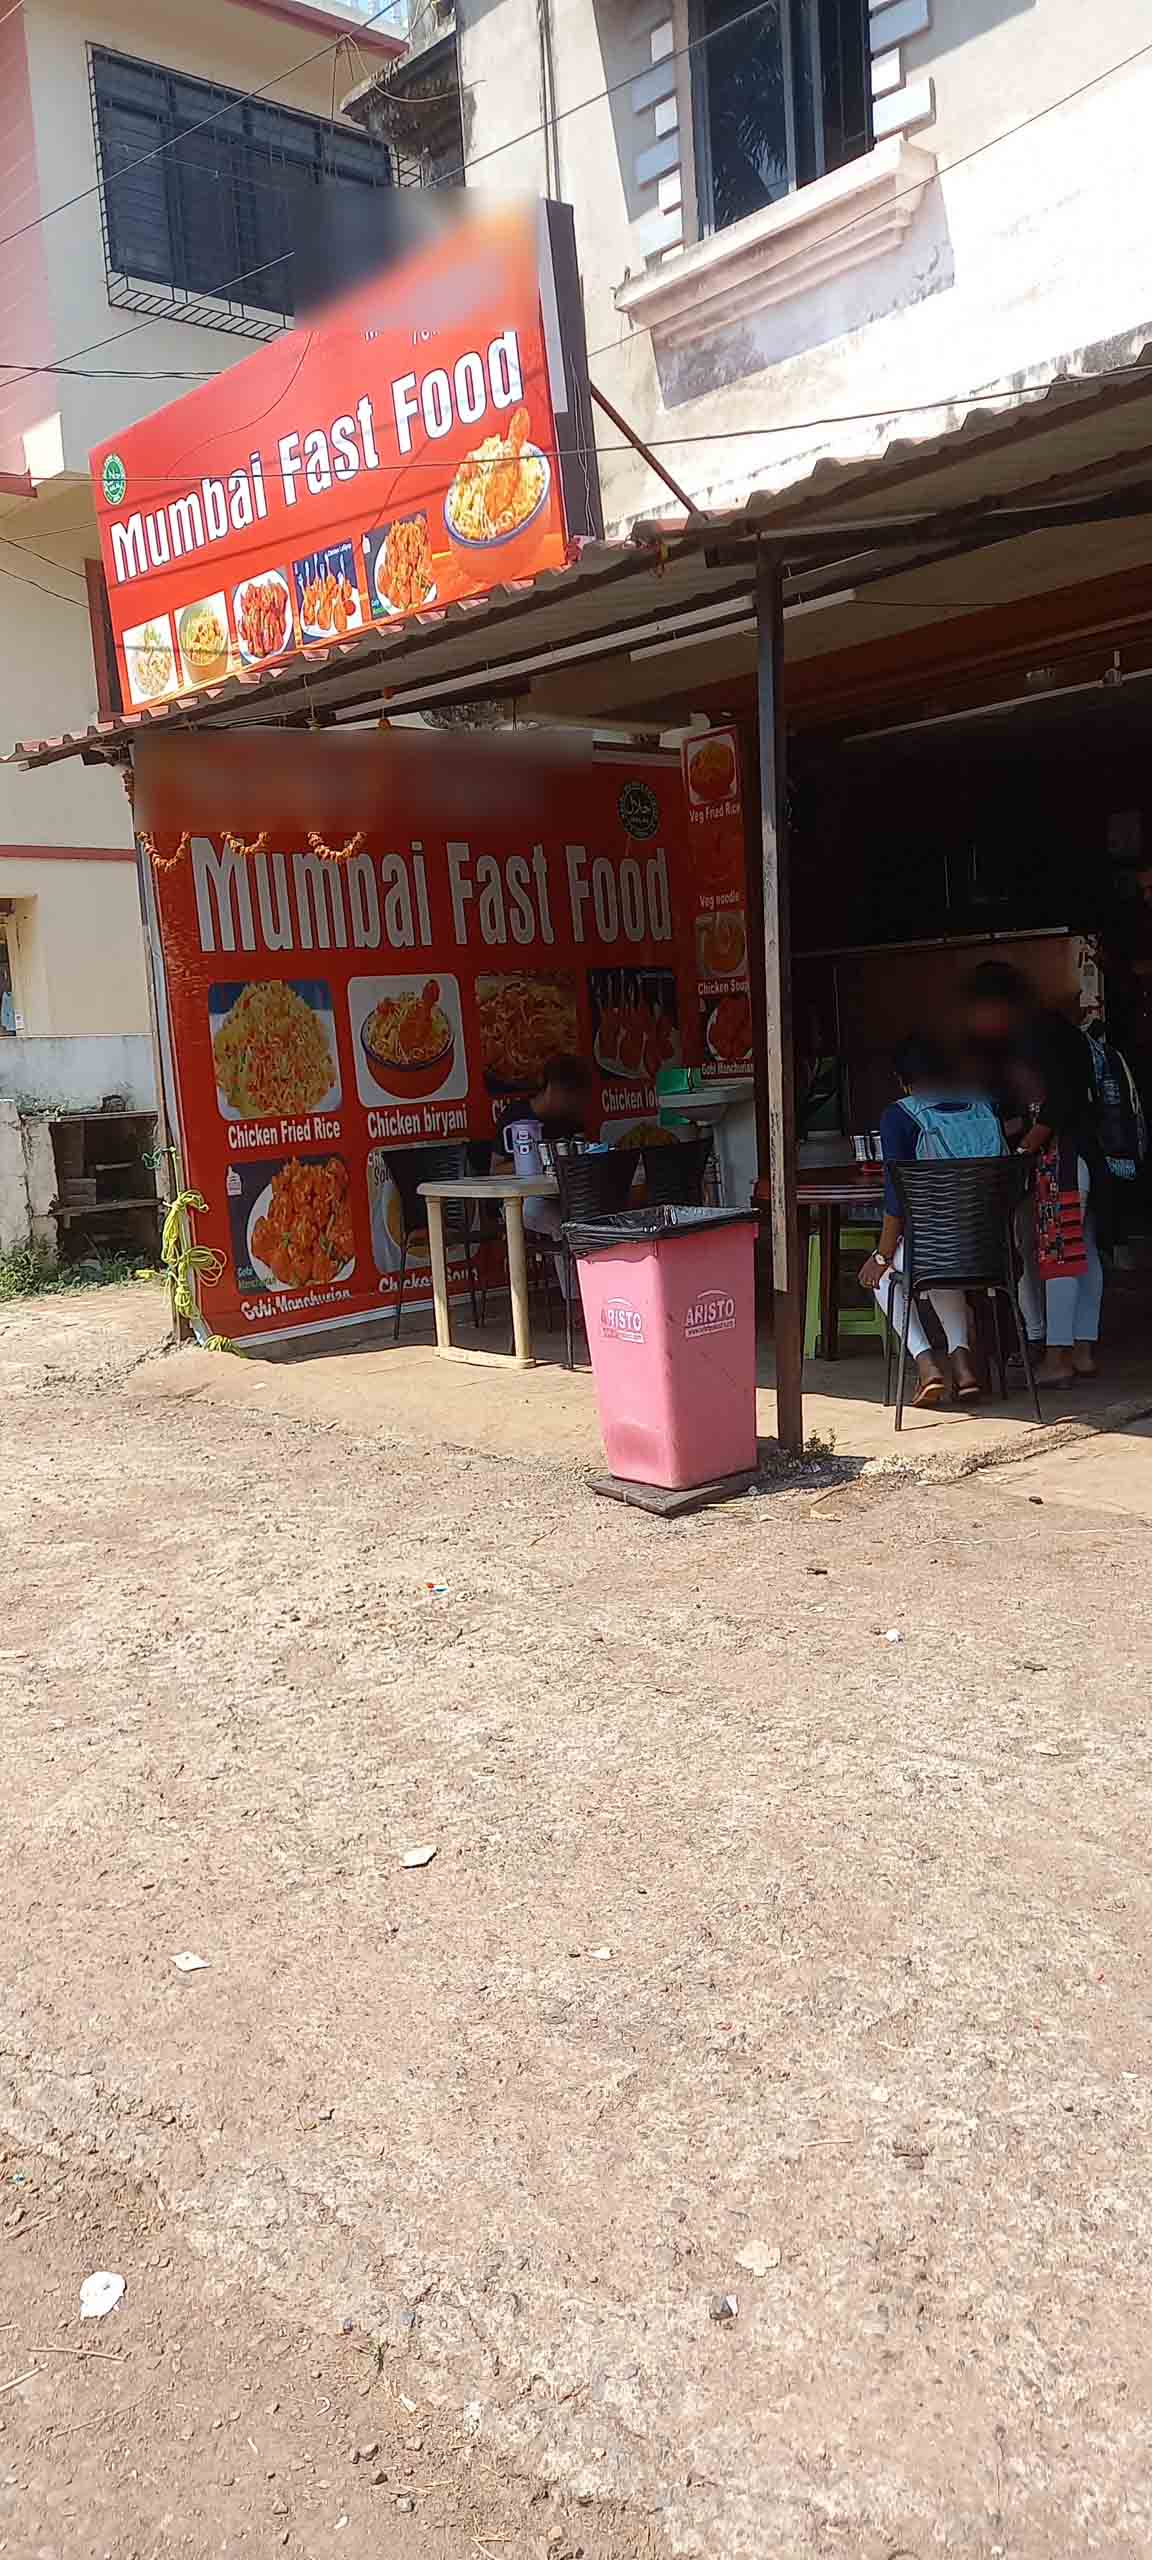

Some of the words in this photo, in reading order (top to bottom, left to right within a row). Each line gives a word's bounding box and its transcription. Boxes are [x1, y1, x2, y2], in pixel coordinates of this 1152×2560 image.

[109, 451, 268, 585] Mumbai
[278, 393, 381, 507] Fast
[391, 329, 525, 456] Food
[689, 809, 705, 824] Veg
[705, 805, 724, 818] Fried
[190, 836, 433, 953] Mumbai
[445, 840, 555, 945] Fast
[565, 844, 674, 943] Food
[699, 895, 715, 911] Veg
[697, 978, 729, 996] Chicken
[601, 1088, 643, 1113] Chicken
[228, 1124, 278, 1149] Chicken
[280, 1119, 312, 1144] Fried
[314, 1116, 342, 1139] Rice
[367, 1110, 421, 1139] Chicken
[423, 1104, 468, 1137] biryani
[600, 1308, 642, 1331] ARISTO
[685, 1298, 735, 1327] ARISTO
